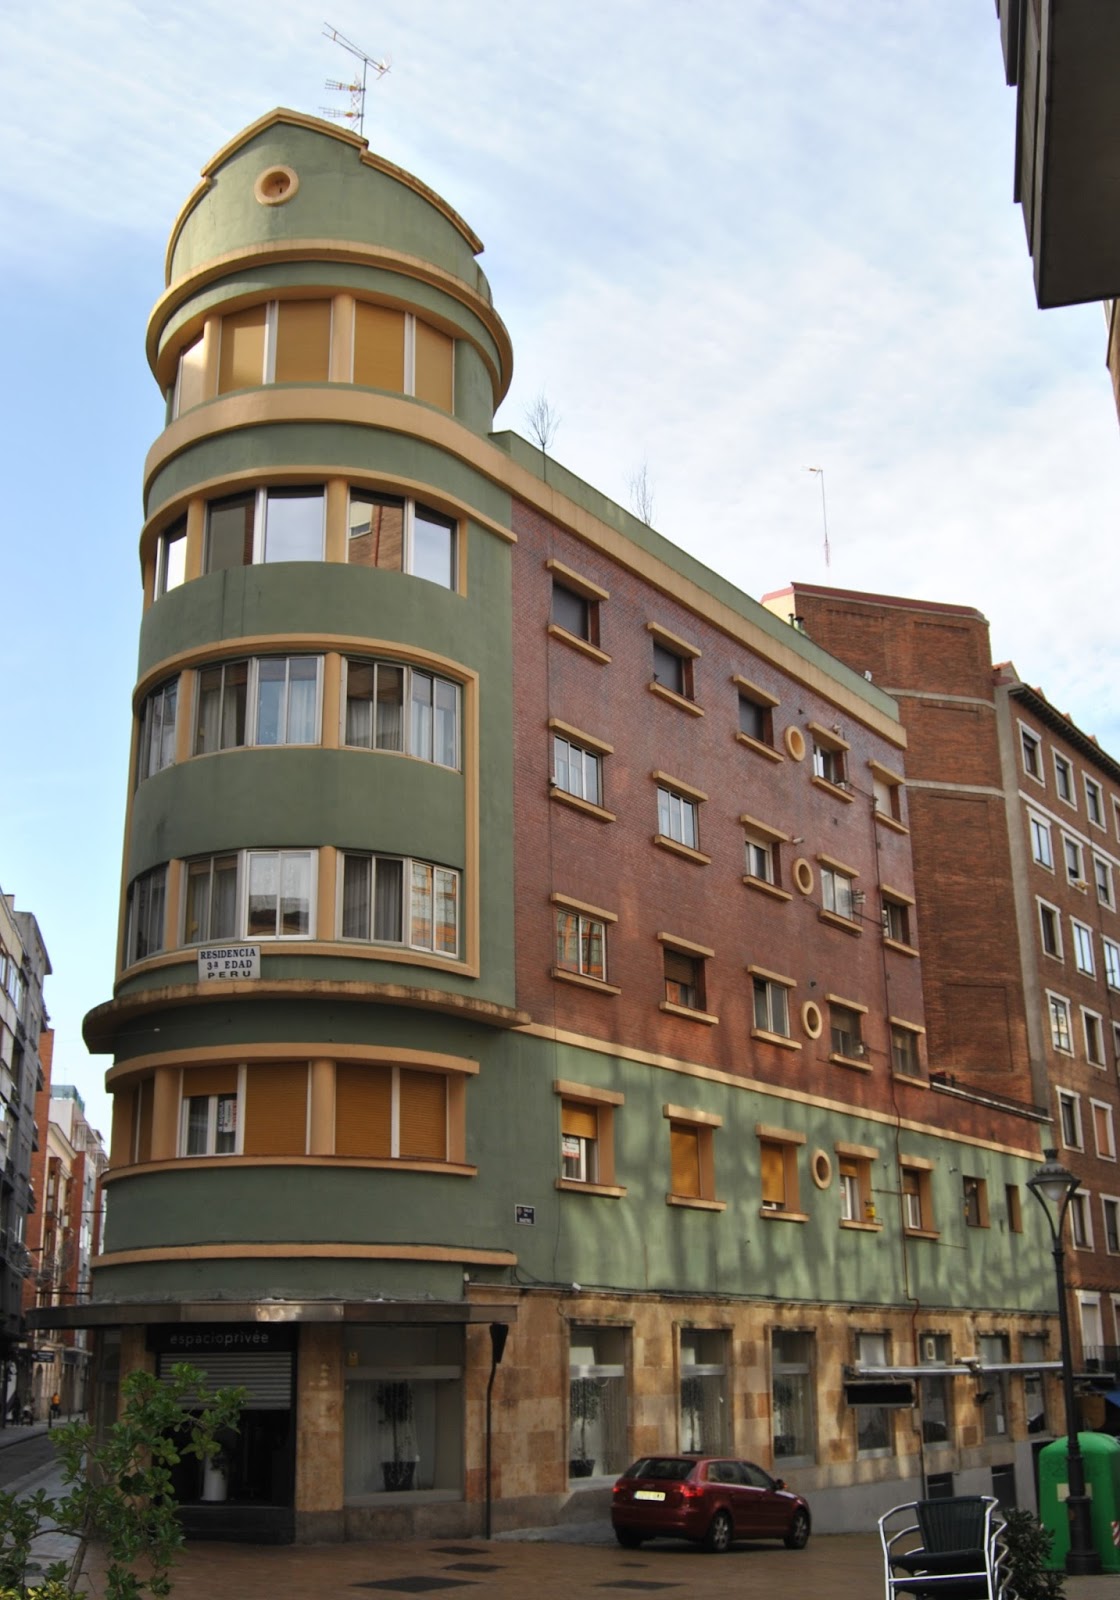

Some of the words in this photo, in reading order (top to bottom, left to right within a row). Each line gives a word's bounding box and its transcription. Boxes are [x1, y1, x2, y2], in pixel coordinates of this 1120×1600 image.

[200, 948, 256, 959] RESIDENCIA
[207, 961, 219, 970] 3ª
[225, 960, 253, 969] EDAD
[208, 971, 251, 979] PERU
